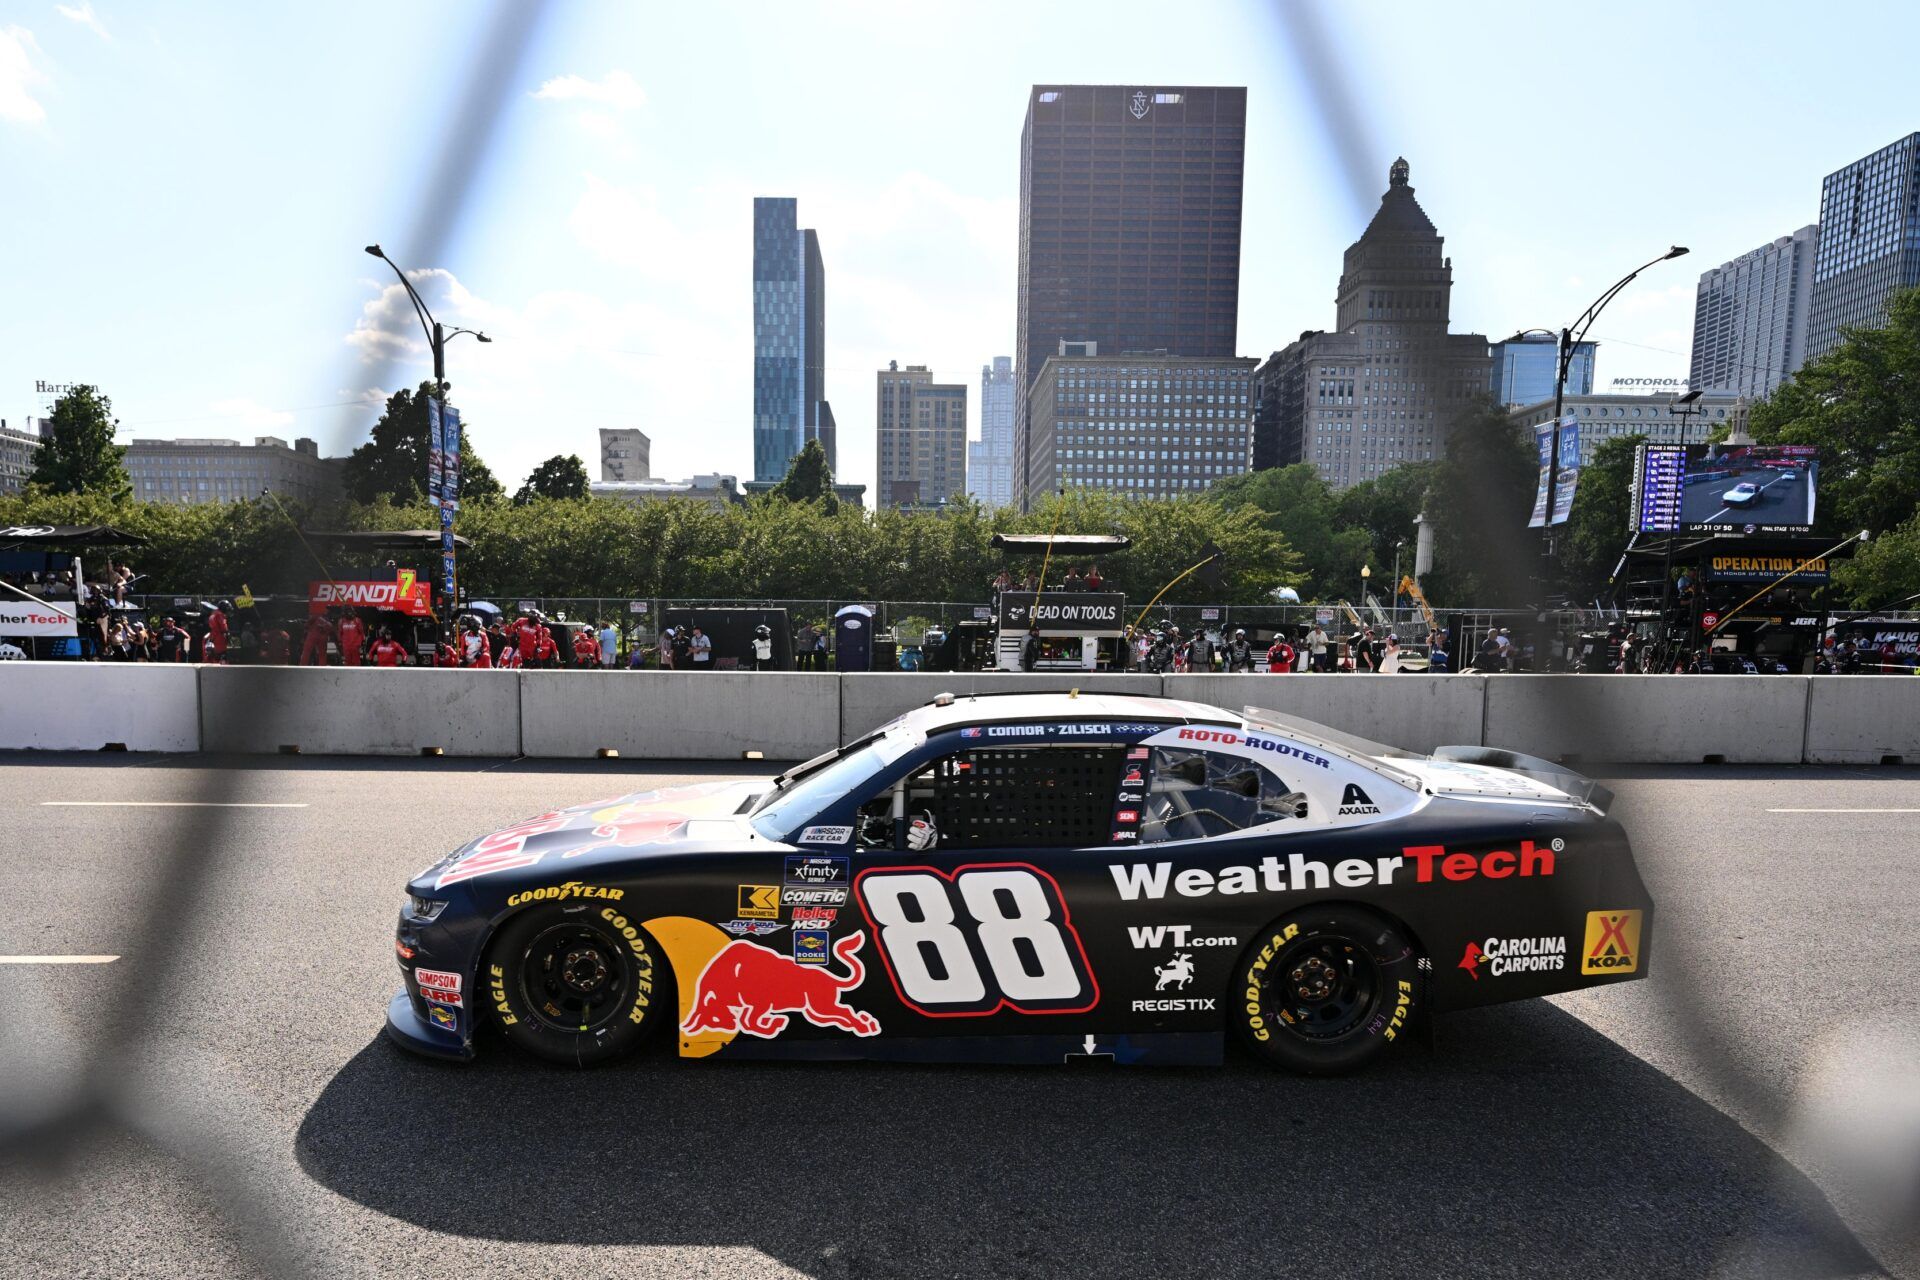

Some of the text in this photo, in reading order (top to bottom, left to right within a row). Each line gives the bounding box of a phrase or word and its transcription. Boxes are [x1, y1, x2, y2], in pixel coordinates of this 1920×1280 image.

[36, 380, 100, 393] Harrin
[1613, 377, 1690, 386] MOTOROLA
[442, 509, 453, 522] 290
[445, 534, 453, 545] 90
[445, 560, 454, 571] 94
[1712, 557, 1827, 572] OPERATION 300
[399, 572, 415, 597] 7
[312, 584, 398, 603] BRANDT
[1029, 605, 1116, 620] DEAD ON TOOLS
[1790, 617, 1818, 626] JGR
[988, 724, 1111, 737] CONNOR ZILISCH
[1178, 729, 1330, 769] ROTO-ROOTER
[1338, 806, 1381, 815] AXALTA
[794, 864, 839, 880] xfinity
[507, 882, 625, 907] GOODYEAR
[783, 889, 846, 903] COMETIC
[791, 907, 838, 921] Holley
[791, 920, 831, 930] MSD
[863, 871, 1081, 1003] 88
[1127, 924, 1237, 949] WT.com
[1484, 936, 1567, 959] CAROLINA
[1490, 955, 1565, 977] CARPORTS
[1587, 955, 1632, 968] KOA
[418, 971, 457, 989] SIMPSON
[420, 988, 461, 1003] ARP
[490, 964, 518, 1025] EAGLE
[1132, 998, 1216, 1012] REGISTIX
[1384, 980, 1411, 1042] EAGLE
